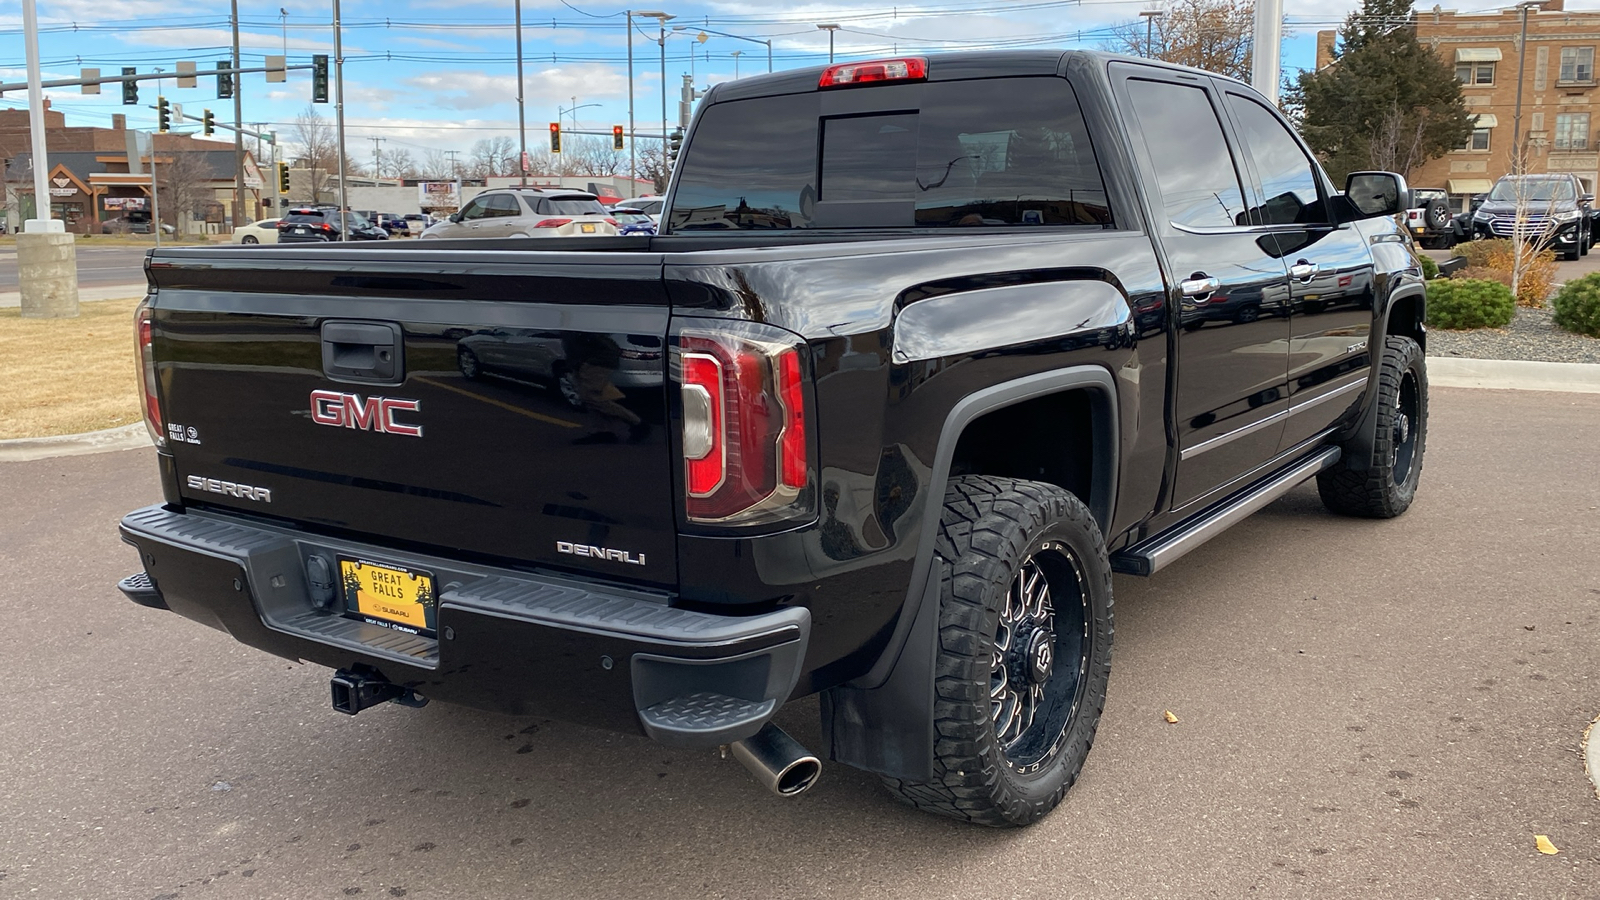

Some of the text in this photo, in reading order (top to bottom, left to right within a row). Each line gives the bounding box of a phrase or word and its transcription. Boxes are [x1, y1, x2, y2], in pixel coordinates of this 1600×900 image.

[310, 389, 424, 438] GMC
[168, 422, 183, 433] GREAT
[169, 431, 185, 442] FALLS
[187, 474, 272, 503] SIERRA
[556, 541, 645, 565] DENALI
[371, 570, 401, 585] GREAT
[373, 582, 403, 598] FALLS
[382, 606, 409, 617] SUBARU
[398, 626, 418, 635] SUBARU
